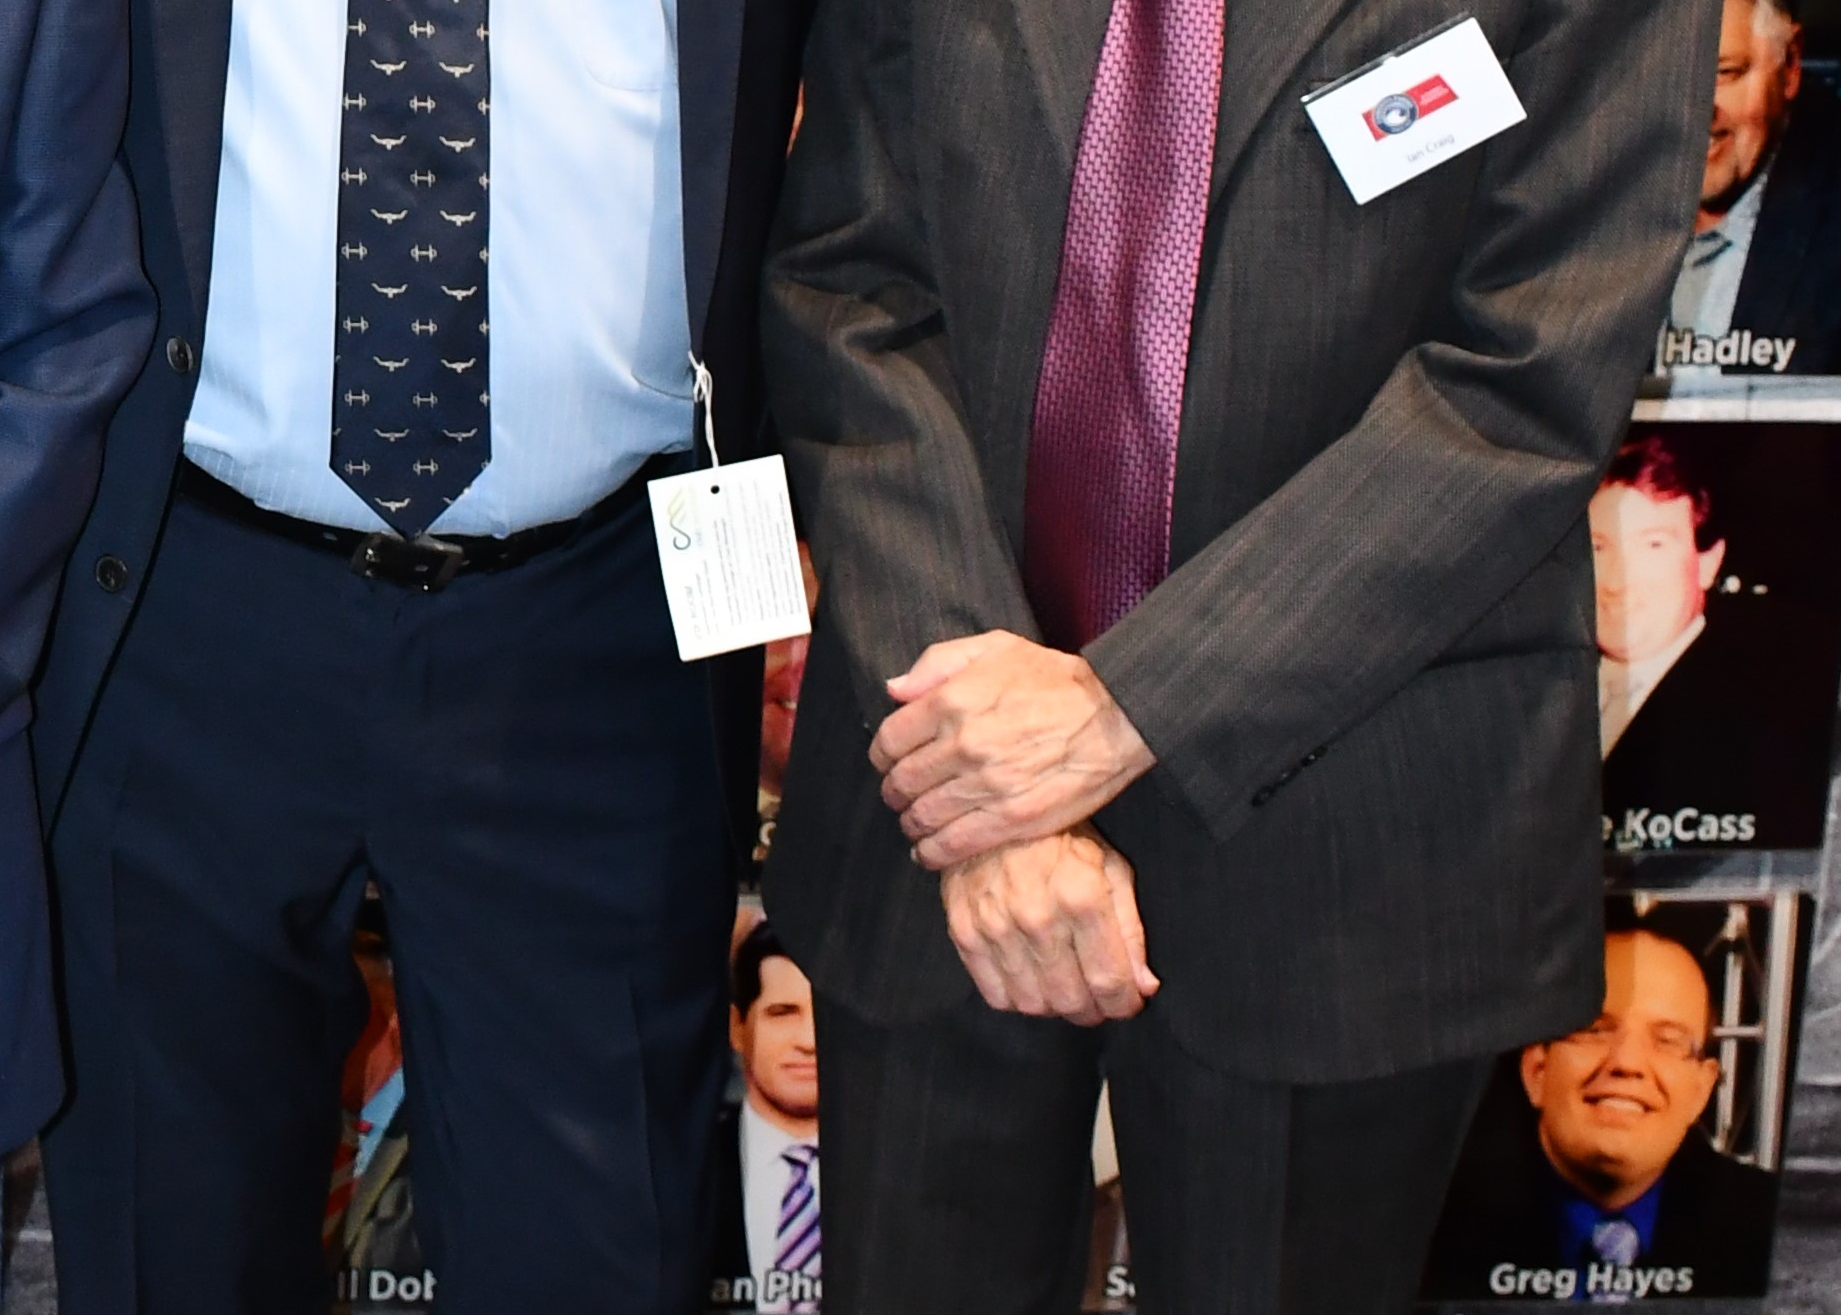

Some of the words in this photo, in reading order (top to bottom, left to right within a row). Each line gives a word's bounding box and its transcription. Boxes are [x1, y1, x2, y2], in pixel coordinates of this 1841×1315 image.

[1665, 329, 1796, 370] Hadley
[1624, 808, 1756, 844] KoCass
[1489, 1262, 1577, 1298] Greg
[1586, 1262, 1694, 1296] Hayes
